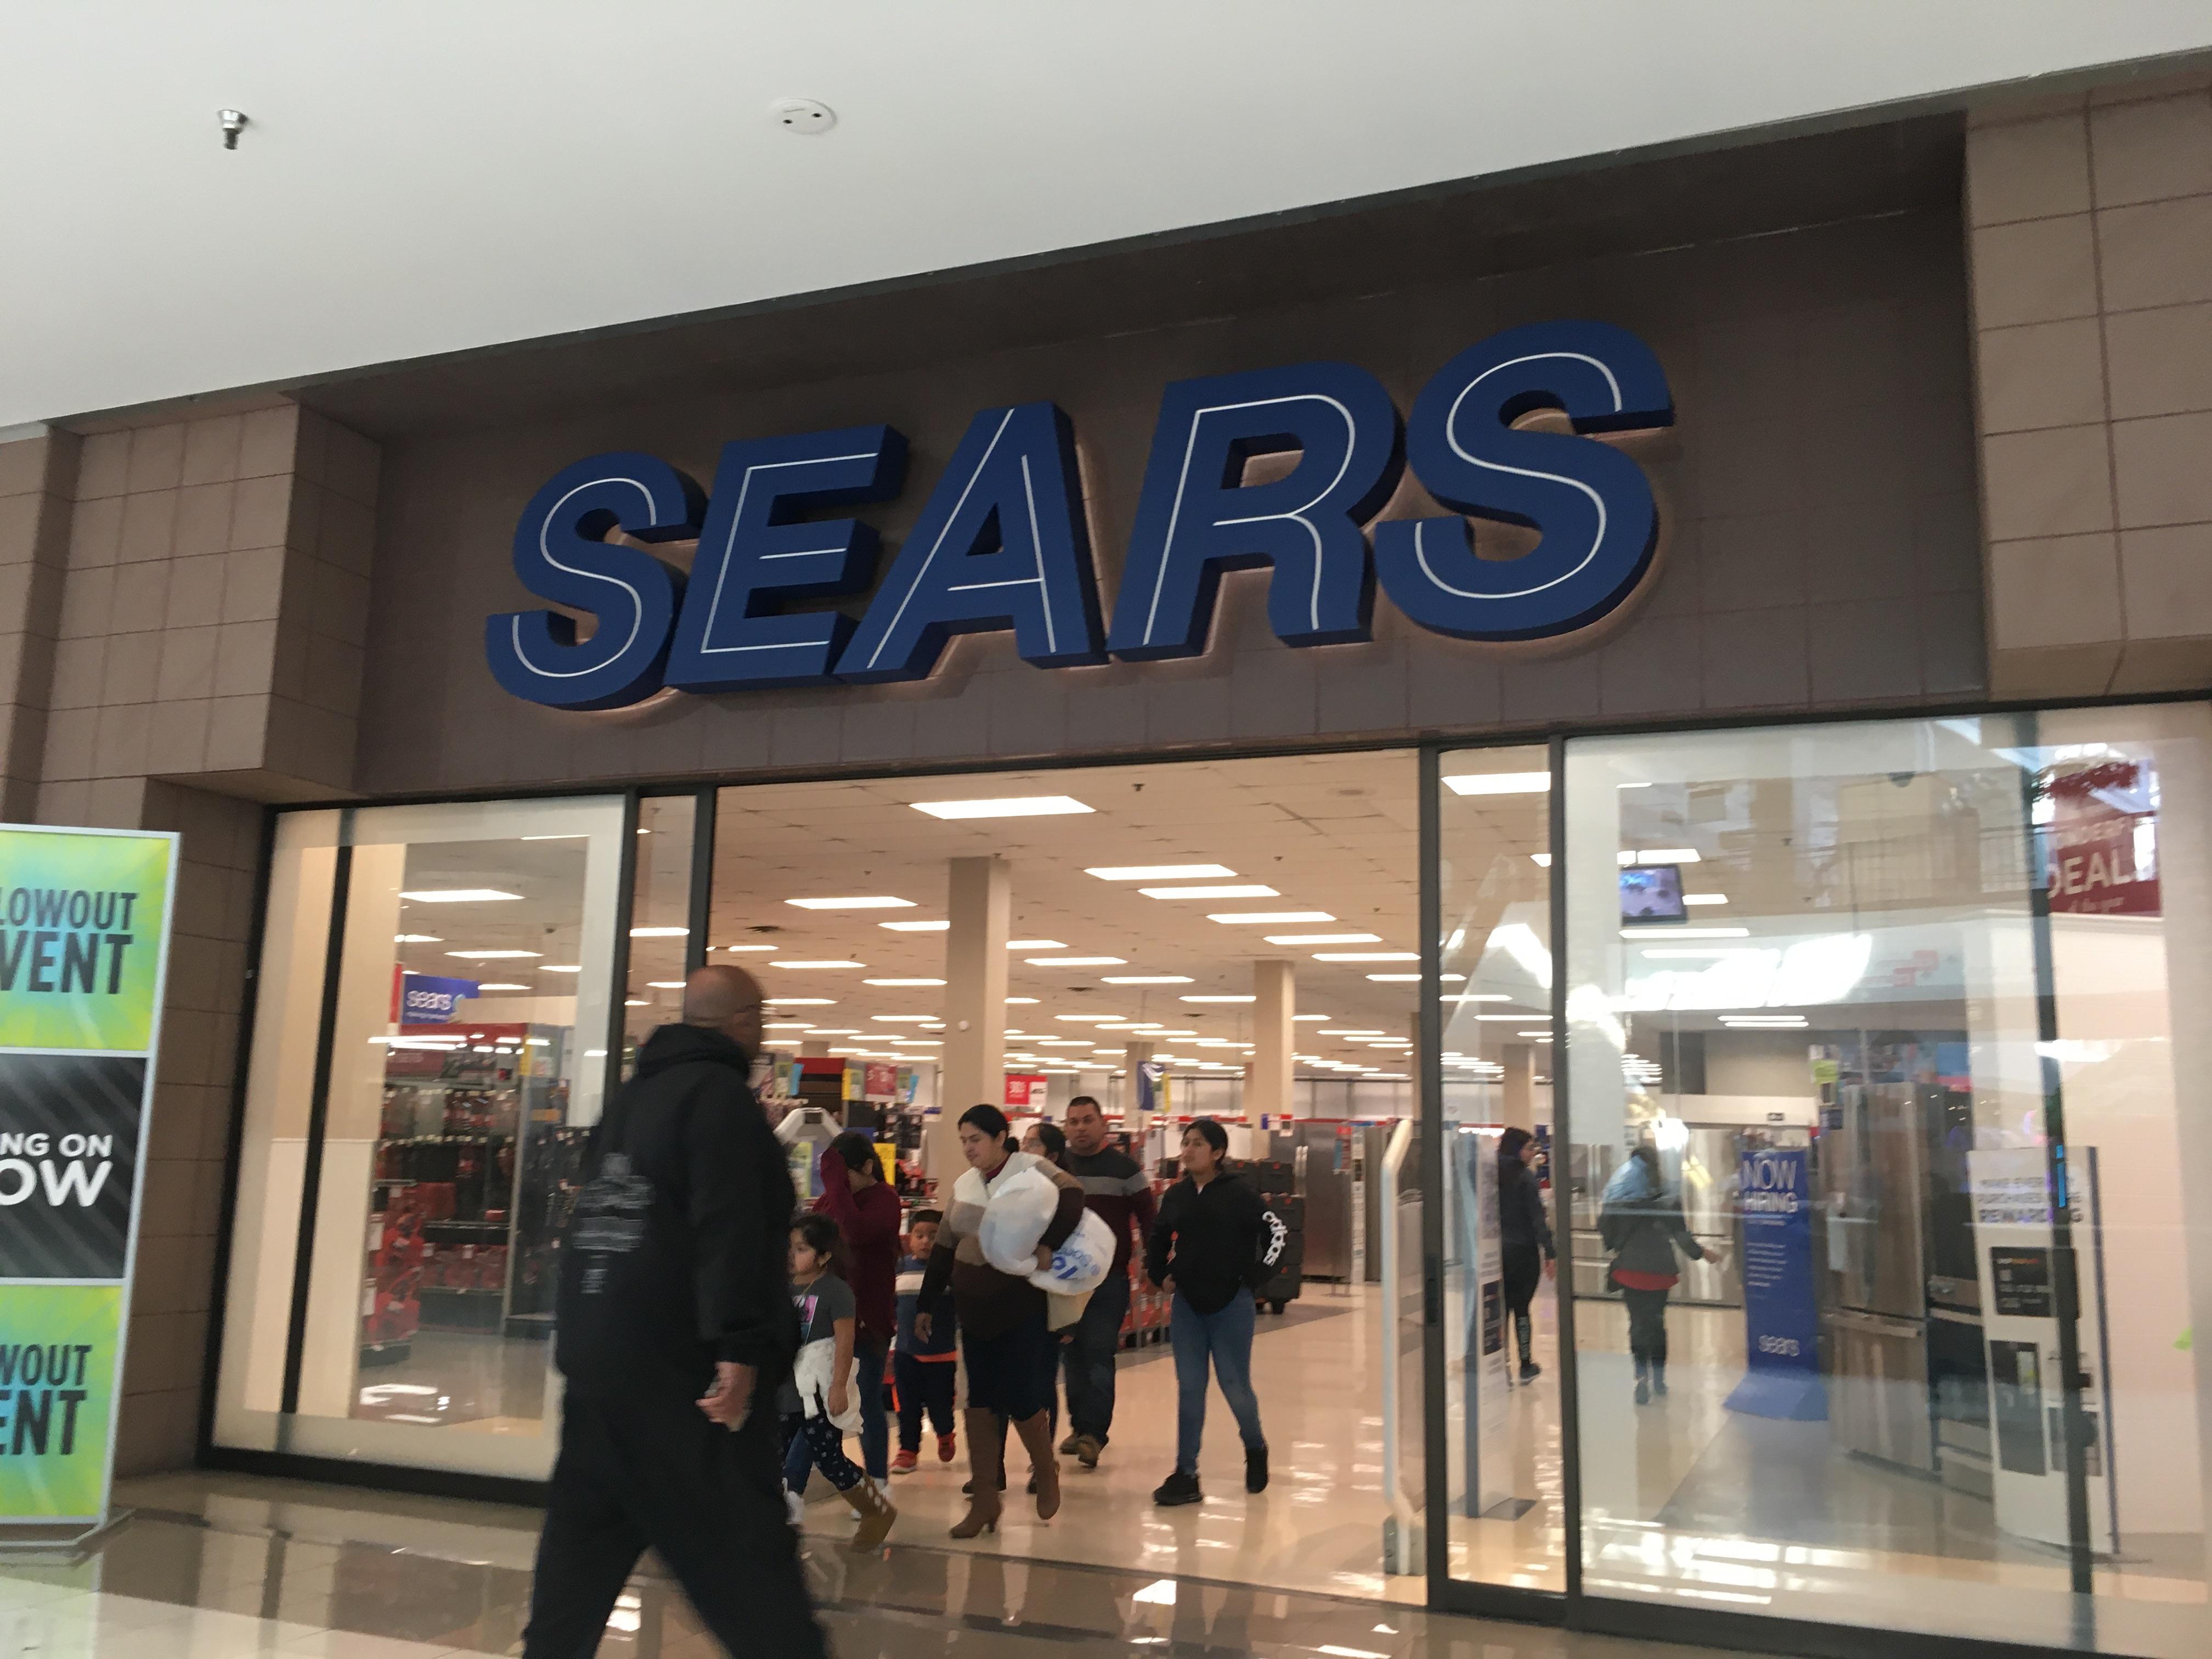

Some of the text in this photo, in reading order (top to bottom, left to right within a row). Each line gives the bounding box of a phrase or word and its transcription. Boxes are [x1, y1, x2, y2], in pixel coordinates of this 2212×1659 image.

[486, 319, 1675, 708] SEARS
[407, 990, 452, 1011] sears
[58, 1133, 113, 1158] ON
[0, 1158, 113, 1207] OW
[1742, 1159, 1797, 1190] NOW
[1744, 1190, 1798, 1214] HIRING
[1262, 1210, 1288, 1267] adidas
[1759, 1334, 1800, 1357] sears
